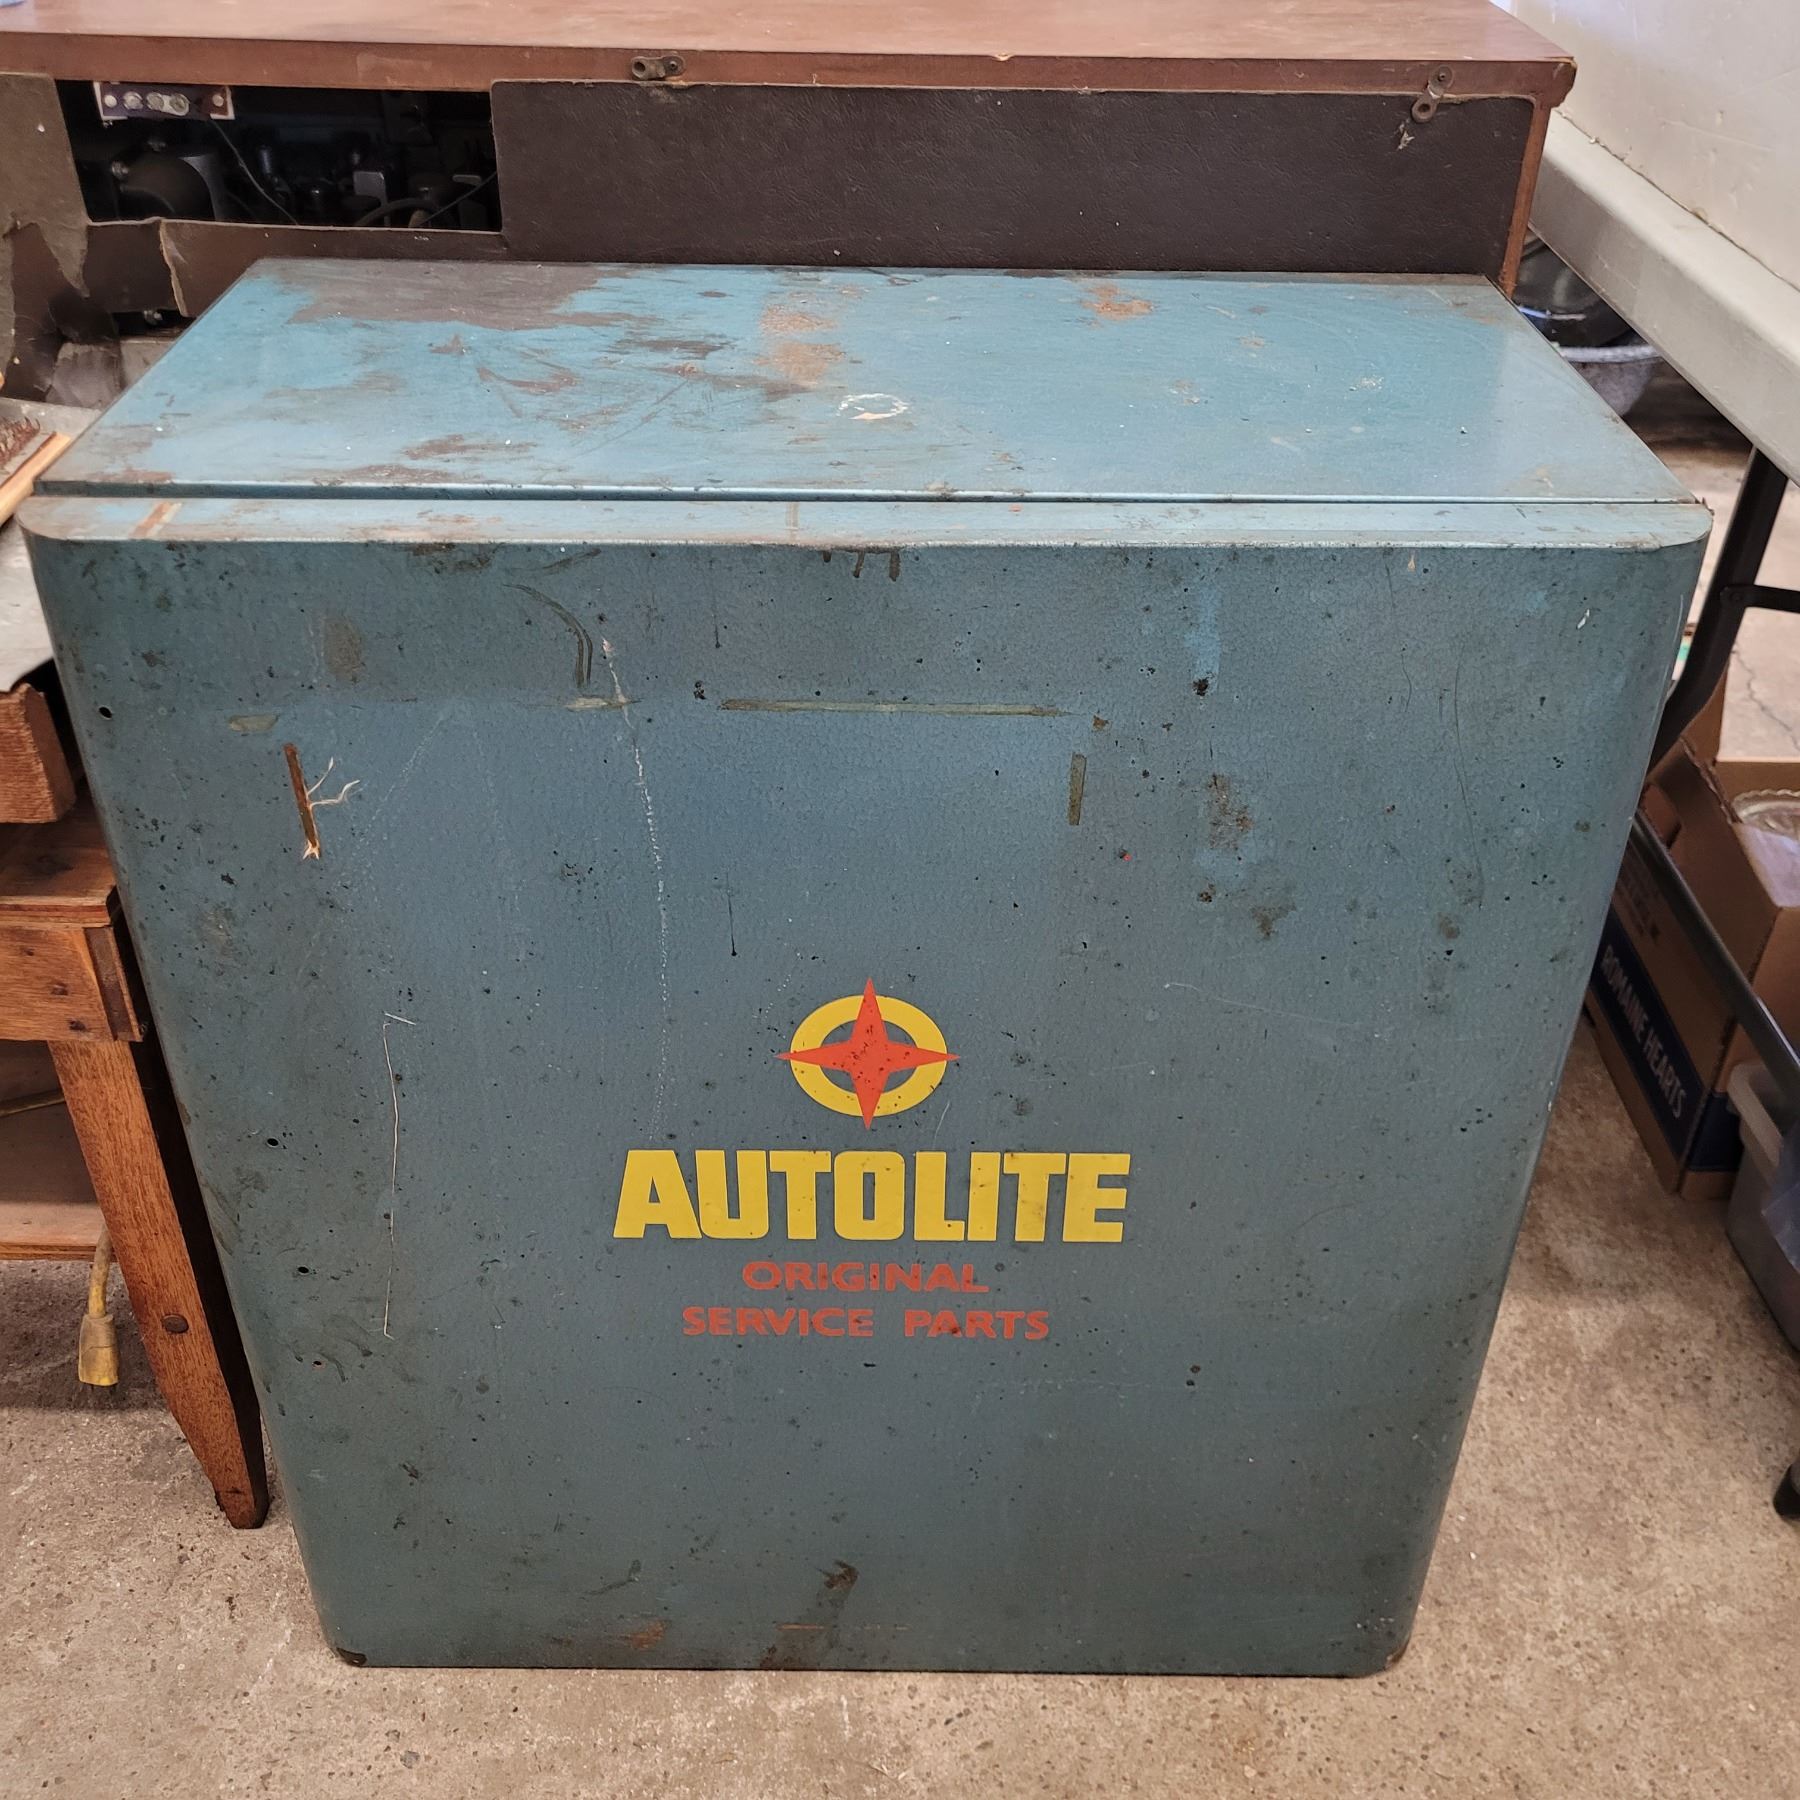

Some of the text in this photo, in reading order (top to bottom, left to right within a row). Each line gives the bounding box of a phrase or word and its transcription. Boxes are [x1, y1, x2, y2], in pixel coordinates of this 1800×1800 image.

[1602, 945, 1648, 1043] ROMAINE
[1643, 1028, 1686, 1118] HEARTS
[613, 1149, 1131, 1243] AUTOLITE
[742, 1260, 990, 1293] ORIGINAL
[683, 1306, 1050, 1340] SERVICE PARTS
